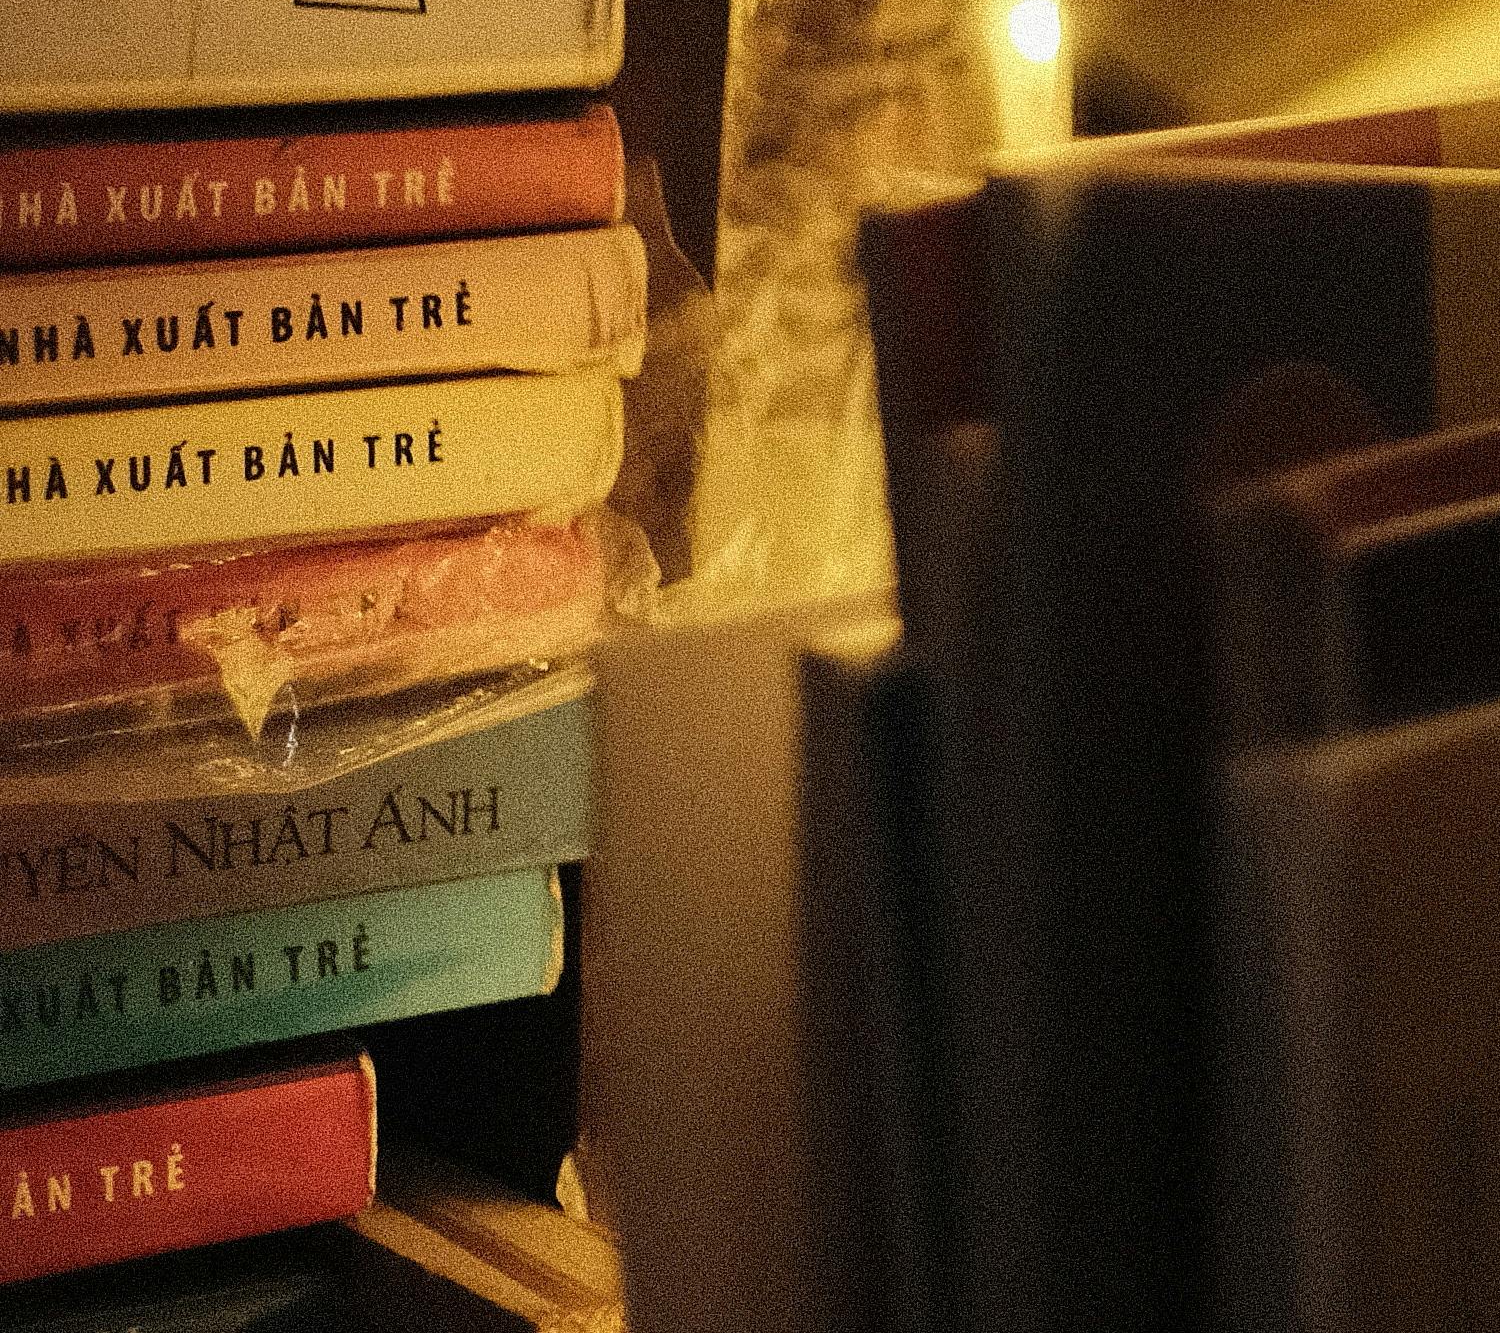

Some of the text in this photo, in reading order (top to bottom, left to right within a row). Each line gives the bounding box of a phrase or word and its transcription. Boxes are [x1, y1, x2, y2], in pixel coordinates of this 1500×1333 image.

[0, 157, 458, 229] HÀ XUẤT BẢN TRẺ
[120, 299, 245, 358] XUẤT
[269, 292, 365, 345] BẢN
[387, 279, 475, 334] TRẺ
[94, 438, 218, 497] XUẤT
[242, 431, 336, 482] BẢN
[363, 418, 447, 471] TRẺ
[163, 801, 349, 880] NHẬT
[157, 947, 254, 1008] BẢN
[283, 923, 373, 983] TRẺ
[97, 1140, 188, 1205] TRẺ
